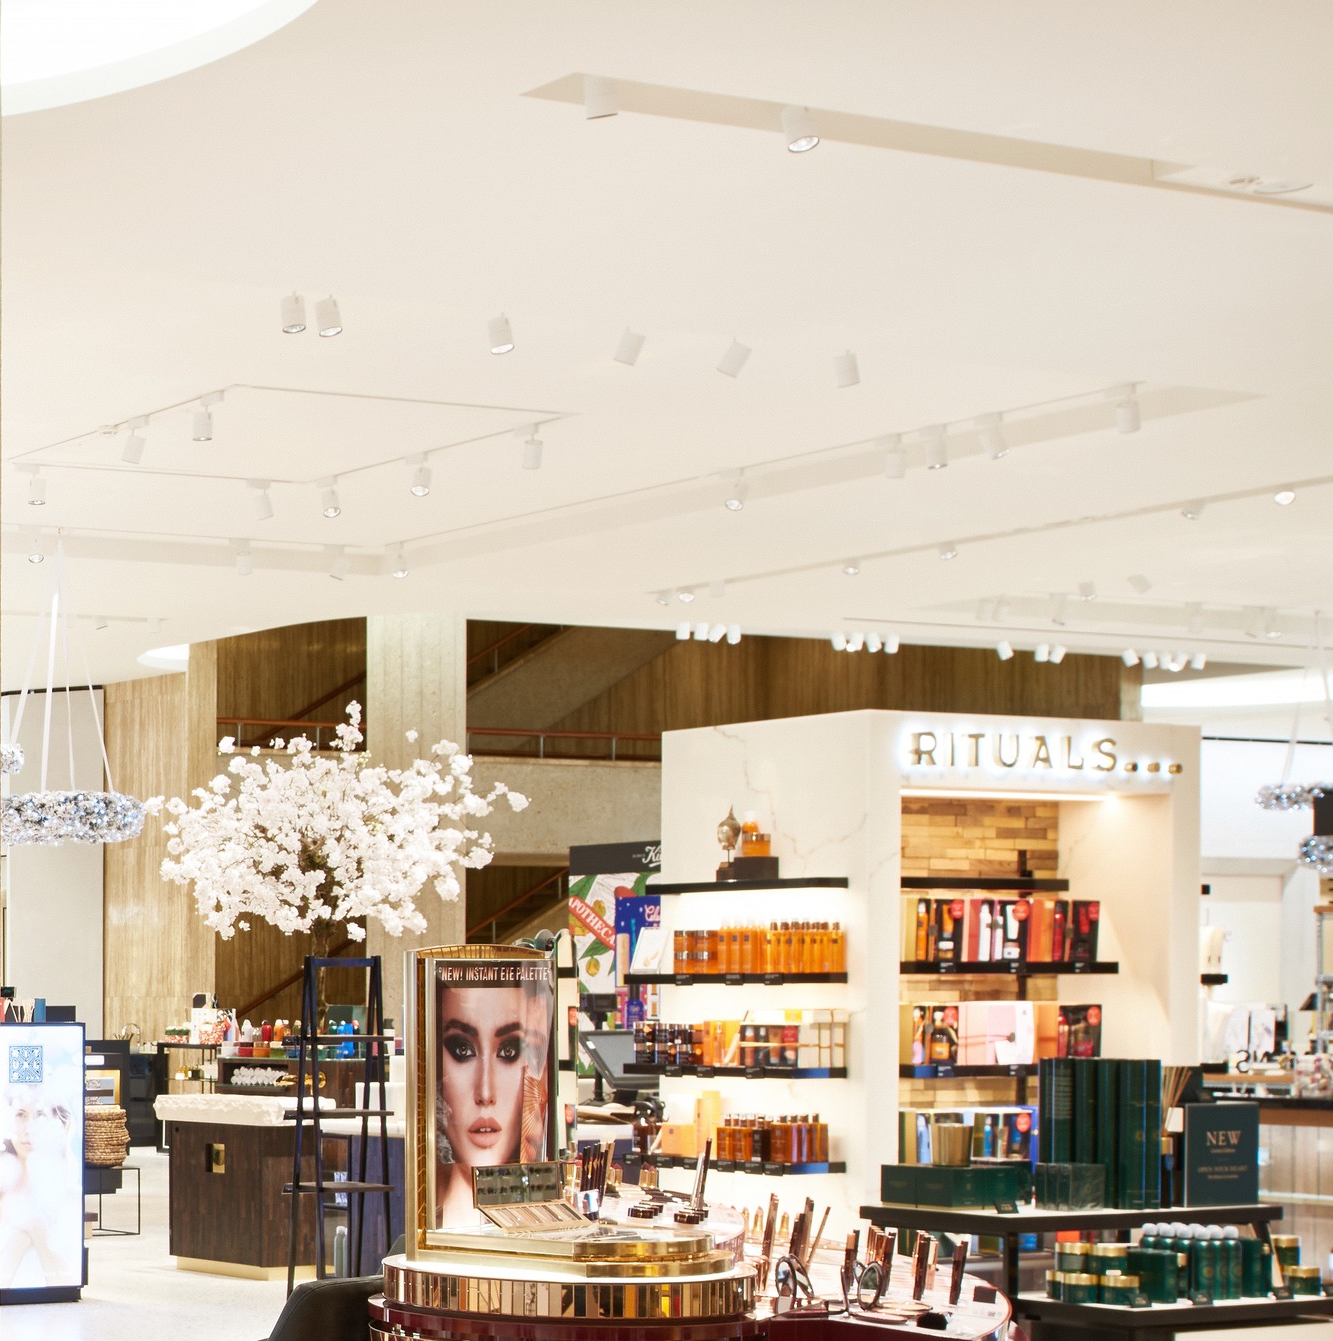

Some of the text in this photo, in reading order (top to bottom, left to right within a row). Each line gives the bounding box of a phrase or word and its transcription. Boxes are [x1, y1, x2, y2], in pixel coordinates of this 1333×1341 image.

[465, 966, 499, 981] INSTANT
[500, 966, 515, 981] EYE
[516, 966, 548, 981] PALETTE
[1206, 1130, 1242, 1146] NEW
